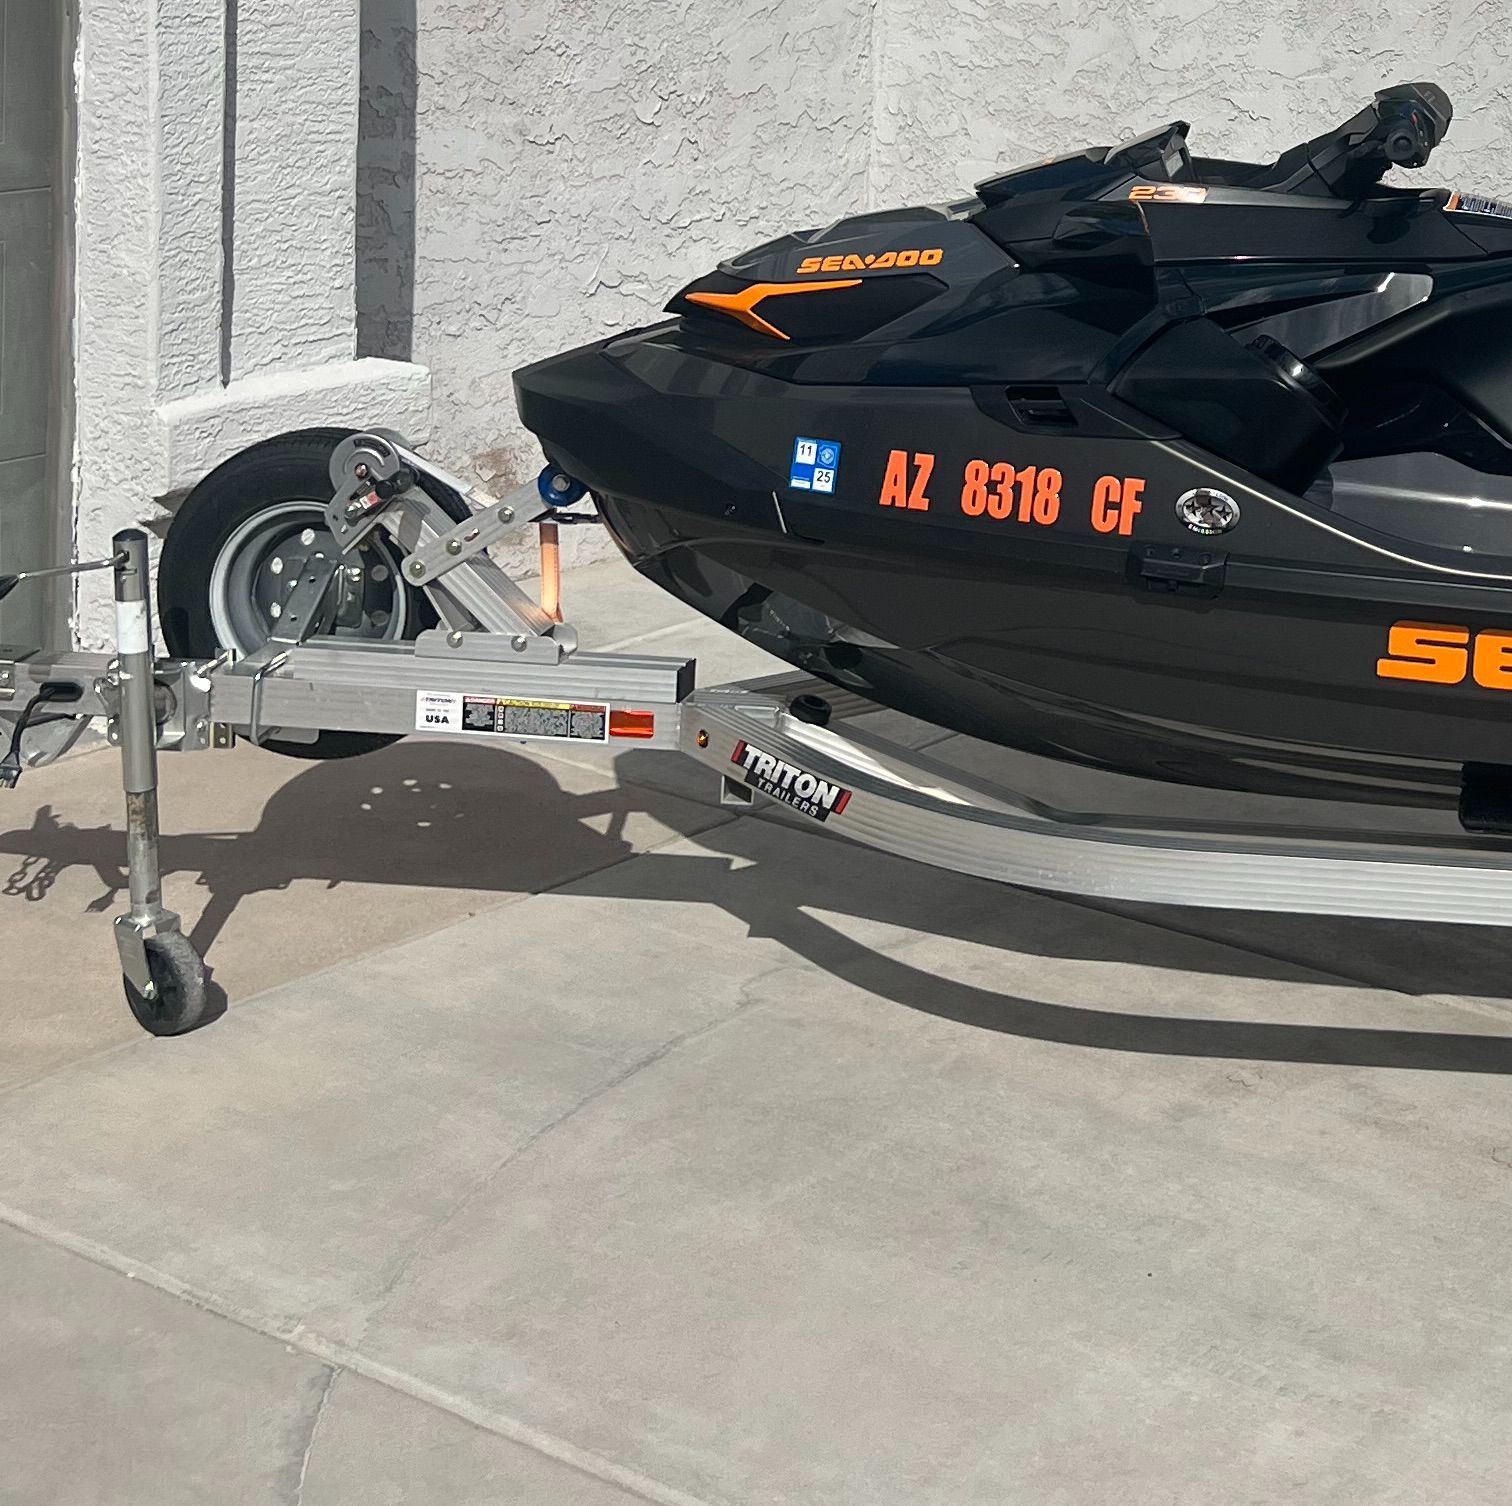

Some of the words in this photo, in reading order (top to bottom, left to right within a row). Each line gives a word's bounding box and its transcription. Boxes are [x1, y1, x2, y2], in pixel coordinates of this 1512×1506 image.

[800, 444, 812, 456] 11
[816, 470, 831, 483] 25
[879, 450, 935, 511] AZ
[961, 459, 1062, 525] 8318
[1091, 475, 1146, 535] CF
[425, 714, 450, 725] USA
[743, 743, 841, 809] TRITON
[757, 778, 819, 817] TRAILERS
